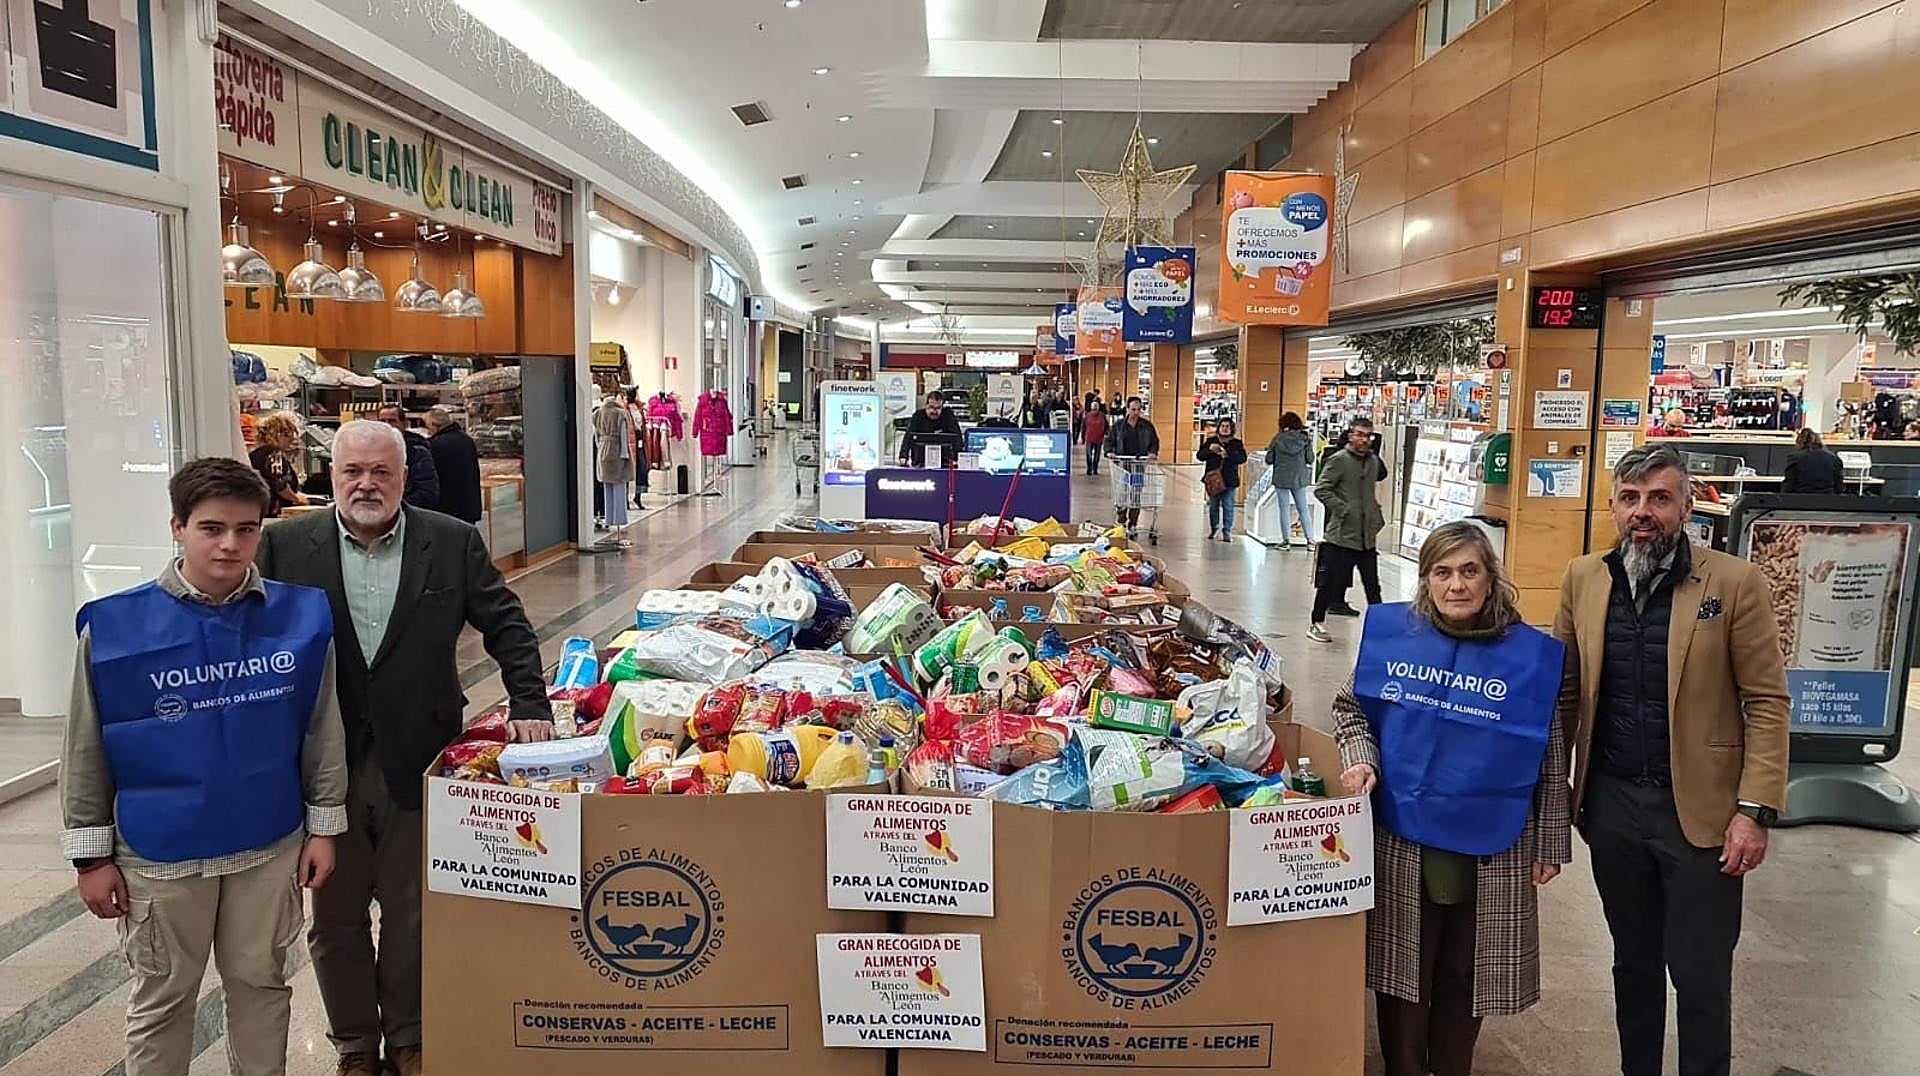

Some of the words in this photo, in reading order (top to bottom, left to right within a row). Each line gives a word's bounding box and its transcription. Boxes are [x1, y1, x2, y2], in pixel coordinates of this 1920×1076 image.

[214, 79, 276, 147] Rápida
[323, 112, 418, 194] CLEAN
[422, 131, 445, 210] &
[450, 164, 514, 226] CLEAN
[1239, 217, 1249, 225] TE
[1289, 212, 1320, 220] PAPEL
[1237, 228, 1298, 238] OFRECEMOS
[1236, 250, 1317, 260] PROMOCIONES
[149, 651, 296, 690] VOLUNTARI@
[1386, 661, 1508, 701] VOLUNTARI@
[192, 695, 232, 710] BANCOS
[233, 693, 246, 704] DE
[1405, 691, 1439, 707] BANCOS
[1440, 701, 1451, 710] DE
[1453, 703, 1501, 721] ALIMENTOS
[448, 785, 479, 800] GRAN
[482, 789, 541, 807] RECOGIDA
[545, 797, 560, 809] DE
[469, 805, 536, 823] ALIMENTOS
[848, 799, 883, 811] GRAN
[887, 800, 951, 814] RECOGIDA
[955, 803, 972, 815] DE
[1250, 812, 1284, 825] GRAN
[1287, 805, 1345, 822] RECOGIDA
[1348, 802, 1361, 815] DE
[496, 822, 508, 831] DEL
[873, 817, 947, 831] ALIMENTOS
[1274, 822, 1341, 840] ALIMENTOS
[474, 831, 509, 844] Banco
[903, 833, 917, 841] DEL
[1301, 840, 1313, 848] DEL
[482, 843, 537, 857] Alimentos
[880, 842, 917, 853] Banco
[888, 853, 948, 865] Alimentos
[1279, 853, 1314, 864] Banco
[432, 859, 467, 874] PARA
[472, 864, 487, 875] LA
[491, 866, 577, 886] COMUNIDAD
[1286, 860, 1340, 874] Alimentos
[461, 877, 548, 897] VALENCIANA
[619, 847, 642, 862] DE
[648, 848, 724, 911] ALIMENTOS
[833, 875, 871, 887] PARA
[876, 876, 894, 887] LA
[898, 877, 989, 893] COMUNIDAD
[1233, 889, 1269, 902] PARA
[1274, 887, 1290, 899] LA
[1294, 876, 1372, 897] COMUNIDAD
[602, 890, 690, 908] FESBAL
[864, 891, 958, 907] VALENCIANA
[1063, 874, 1113, 931] BANCOS
[1118, 866, 1141, 881] DE
[1146, 867, 1218, 930] ALIMENTOS
[1262, 896, 1348, 915] VALENCIANA
[1097, 910, 1185, 927] FESBAL
[838, 939, 873, 951] GRAN
[877, 939, 941, 950] RECOGIDA
[945, 939, 961, 950] DE
[570, 929, 621, 983] BANCOS
[624, 976, 648, 991] DE
[653, 928, 725, 992] ALIMENTOS
[864, 956, 937, 967] ALIMENTOS
[871, 980, 908, 990] Banco
[1062, 948, 1109, 1002] BANCOS
[1112, 997, 1135, 1010] DE
[1141, 946, 1217, 1011] ALIMENTOS
[524, 999, 571, 1009] Donación
[574, 1001, 643, 1010] recomendada
[880, 991, 939, 1002] Alimentos
[522, 1015, 626, 1031] CONSERVAS
[641, 1017, 704, 1031] ACEITE
[719, 1016, 777, 1031] LECHE
[827, 1014, 865, 1025] PARA
[870, 1014, 887, 1025] LA
[891, 1014, 981, 1027] COMUNIDAD
[1007, 1016, 1056, 1028] Donación
[1058, 1020, 1129, 1029] recomendada
[545, 1034, 591, 1045] (PESCADO
[593, 1035, 600, 1043] Y
[601, 1035, 654, 1045] VERDURAS)
[859, 1029, 951, 1041] VALENCIANA
[1004, 1032, 1110, 1048] CONSERVAS
[1124, 1036, 1188, 1049] ACEITE
[1203, 1035, 1260, 1049] LECHE
[1026, 1051, 1073, 1061] (PESCADO
[1075, 1053, 1081, 1061] Y
[1083, 1053, 1136, 1062] VERDURAS)
